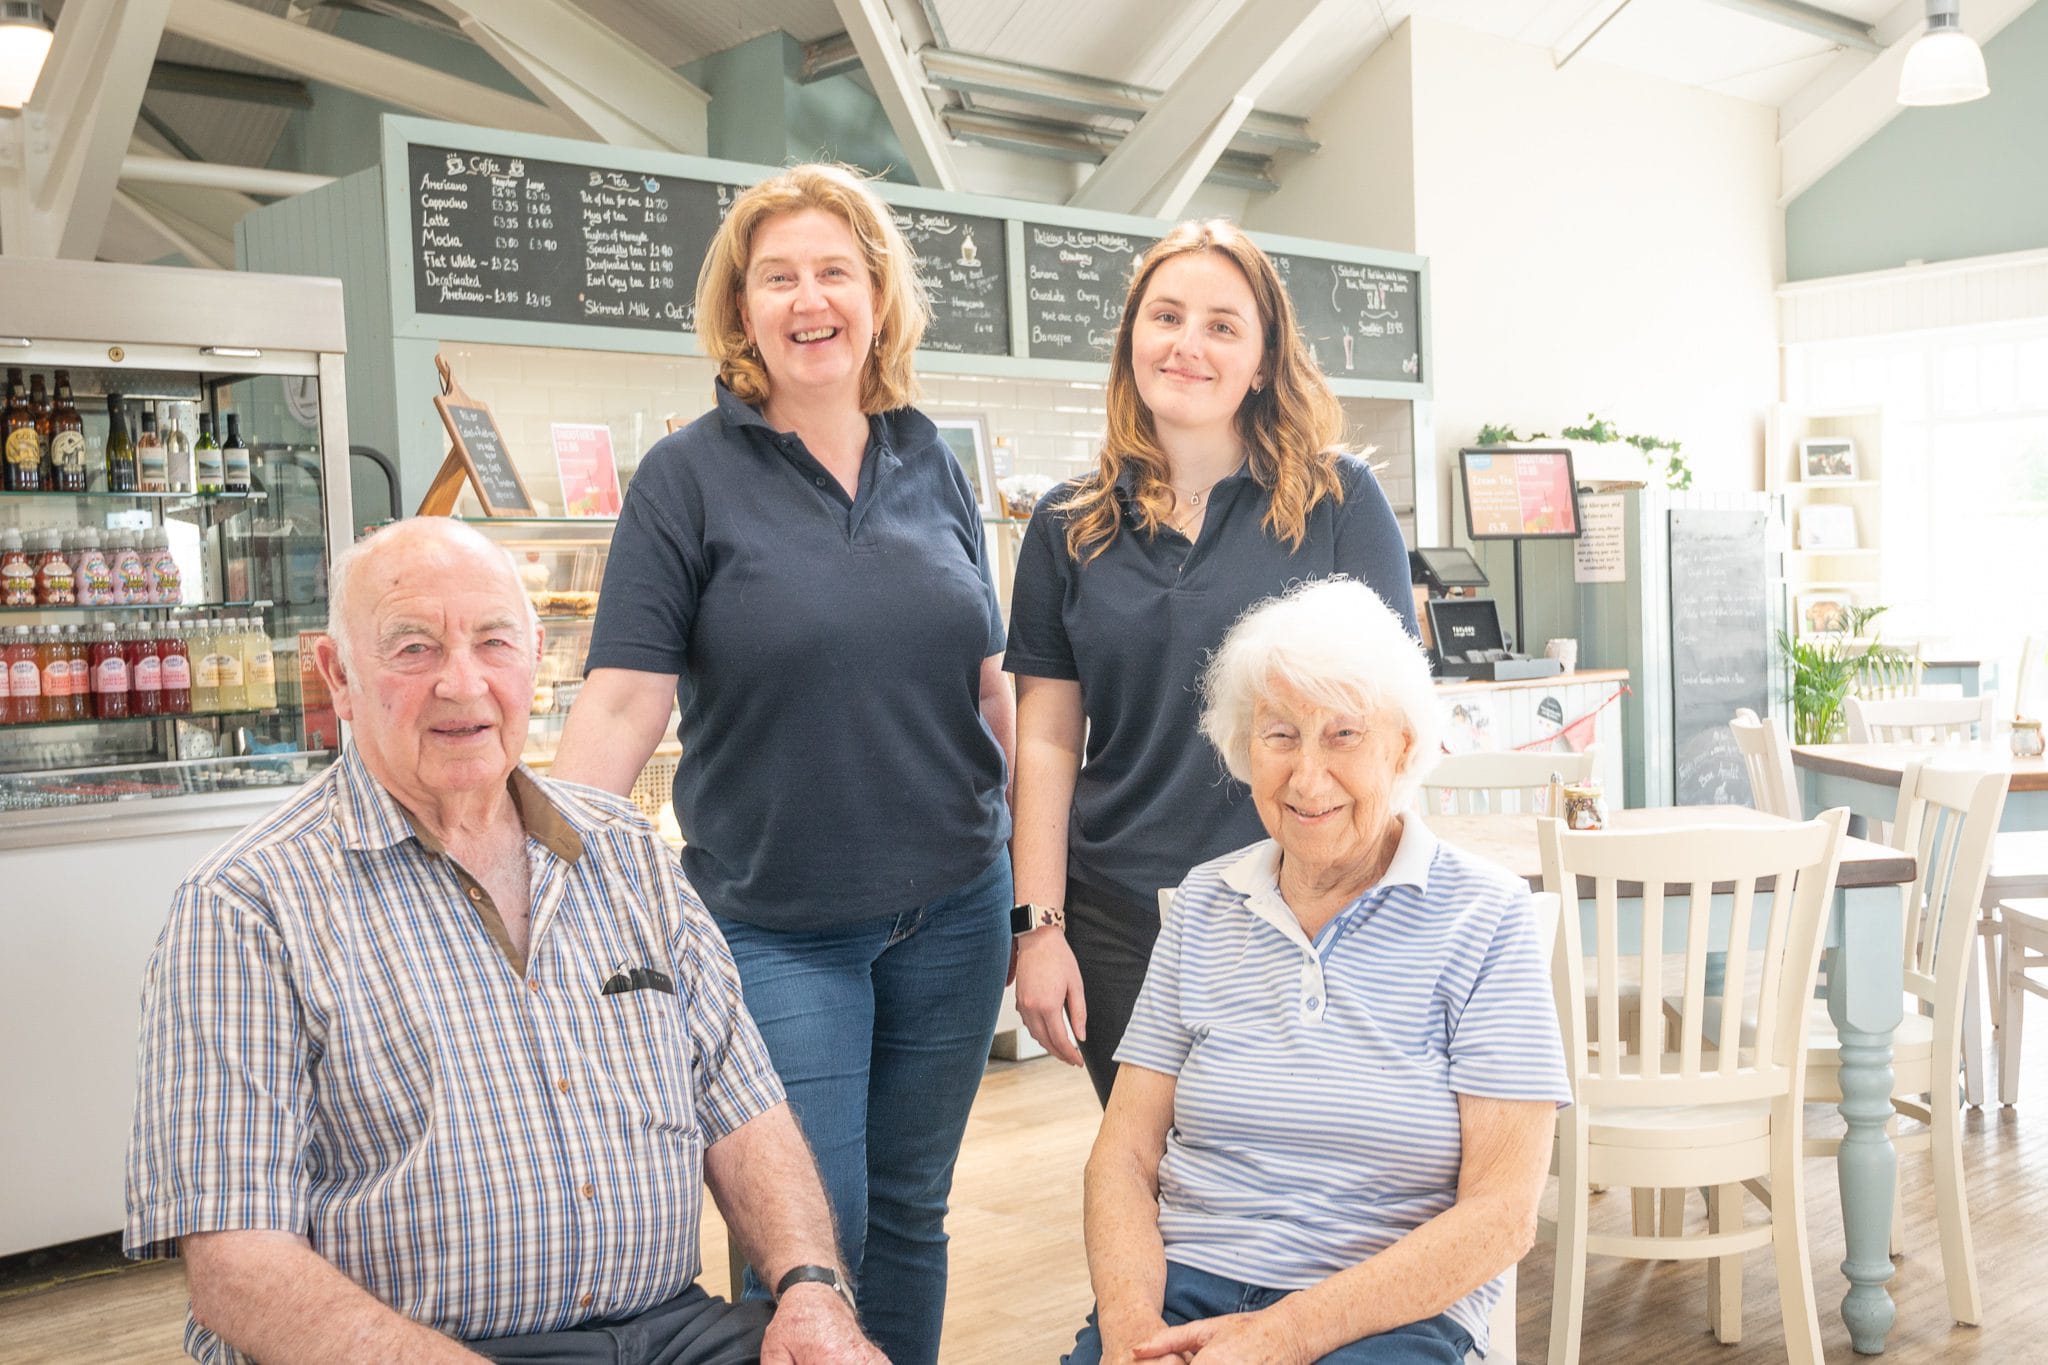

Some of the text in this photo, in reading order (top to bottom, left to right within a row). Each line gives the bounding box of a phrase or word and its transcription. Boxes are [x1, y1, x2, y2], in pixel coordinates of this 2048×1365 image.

[470, 156, 500, 177] Coffee
[420, 173, 468, 192] Americano
[526, 178, 546, 192] Large
[607, 173, 629, 188] Tea
[594, 193, 601, 207] of
[422, 210, 450, 227] Latte
[583, 208, 602, 226] Mug
[603, 209, 611, 224] of
[613, 210, 628, 222] tea
[422, 228, 463, 248] Mocha
[1034, 228, 1064, 242] Delicious
[423, 250, 447, 269] Flat
[450, 253, 477, 269] White
[631, 260, 645, 272] tea
[1030, 264, 1059, 280] Banana
[586, 273, 605, 287] Earl
[607, 274, 628, 293] Grey
[630, 276, 645, 288] tea
[440, 286, 484, 303] Americano
[1030, 288, 1100, 310] Chocolate Cherry
[628, 300, 650, 317] Milk
[664, 302, 684, 319] Oat
[1032, 325, 1072, 347] Banoffee
